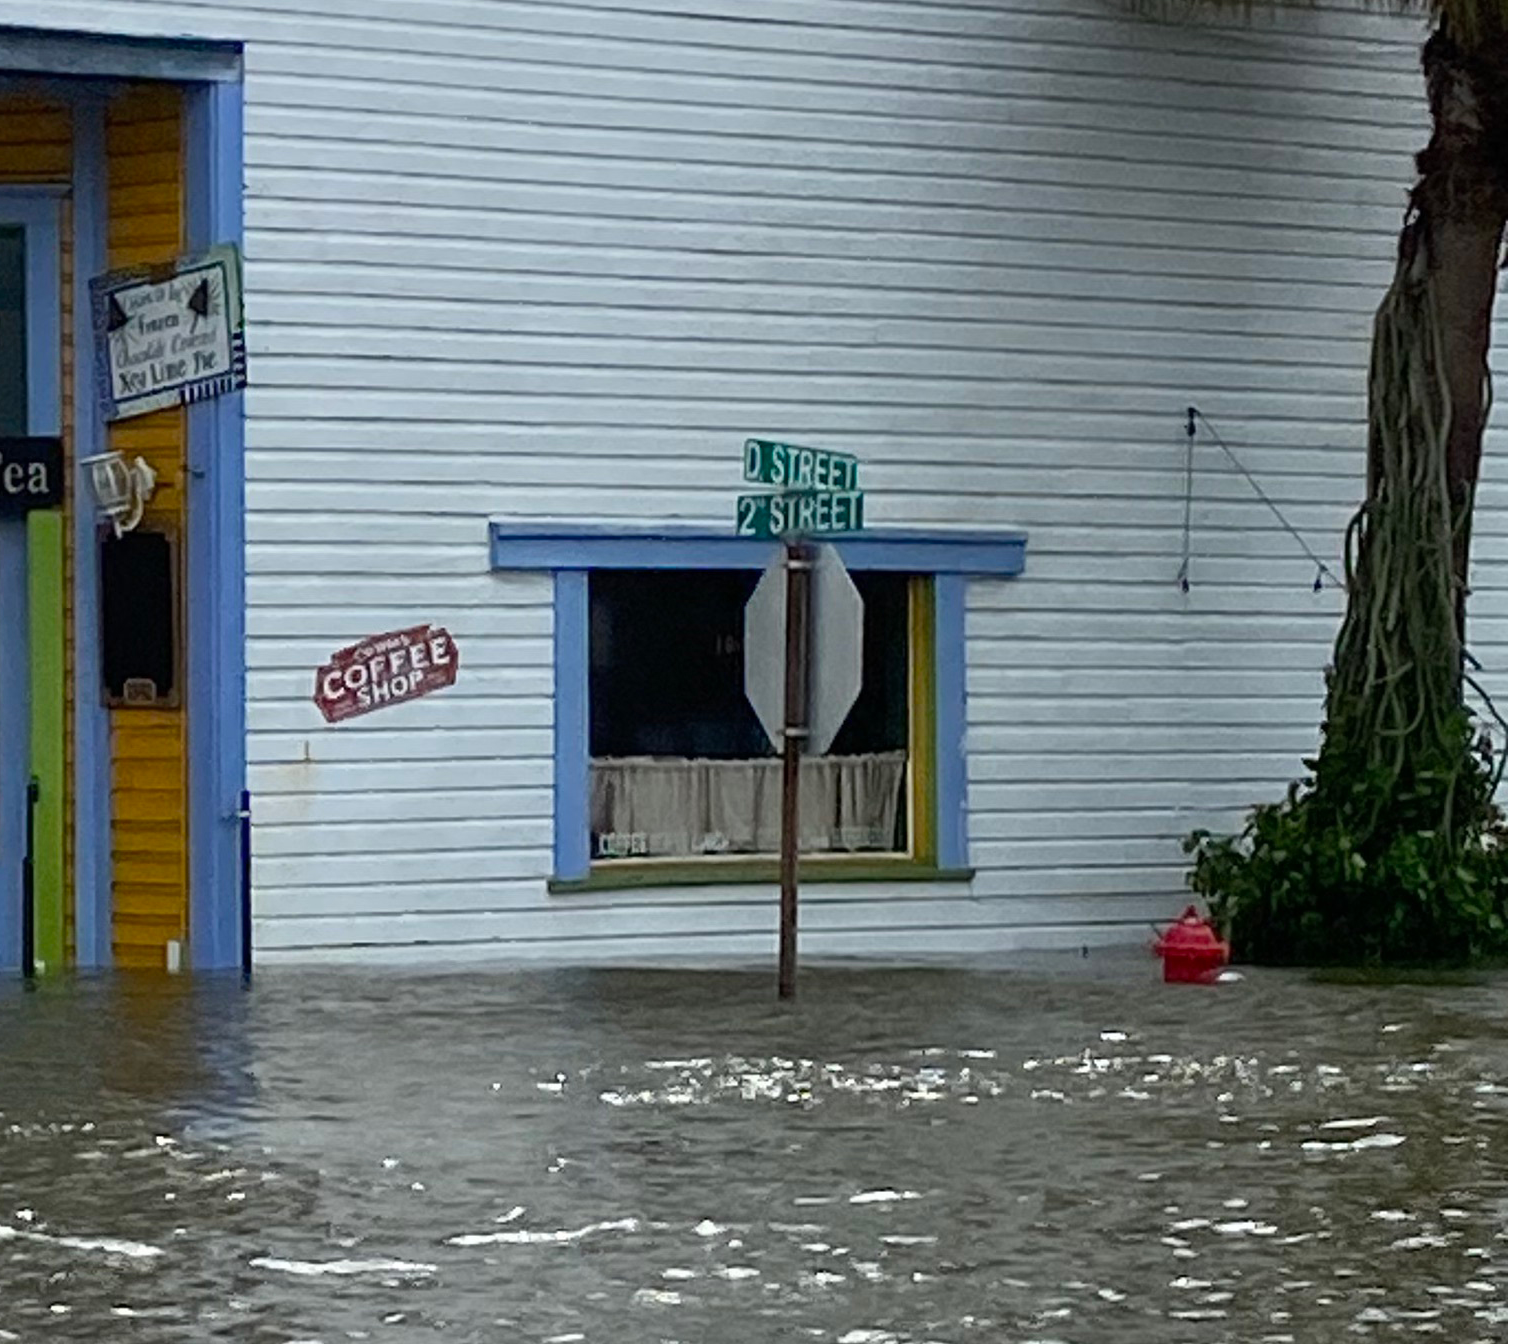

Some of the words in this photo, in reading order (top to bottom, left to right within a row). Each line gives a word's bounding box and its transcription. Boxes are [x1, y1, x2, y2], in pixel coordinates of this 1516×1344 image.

[770, 444, 859, 490] STREET
[768, 489, 863, 535] STREET
[323, 635, 451, 700] COFFEE
[355, 669, 425, 709] SHOP
